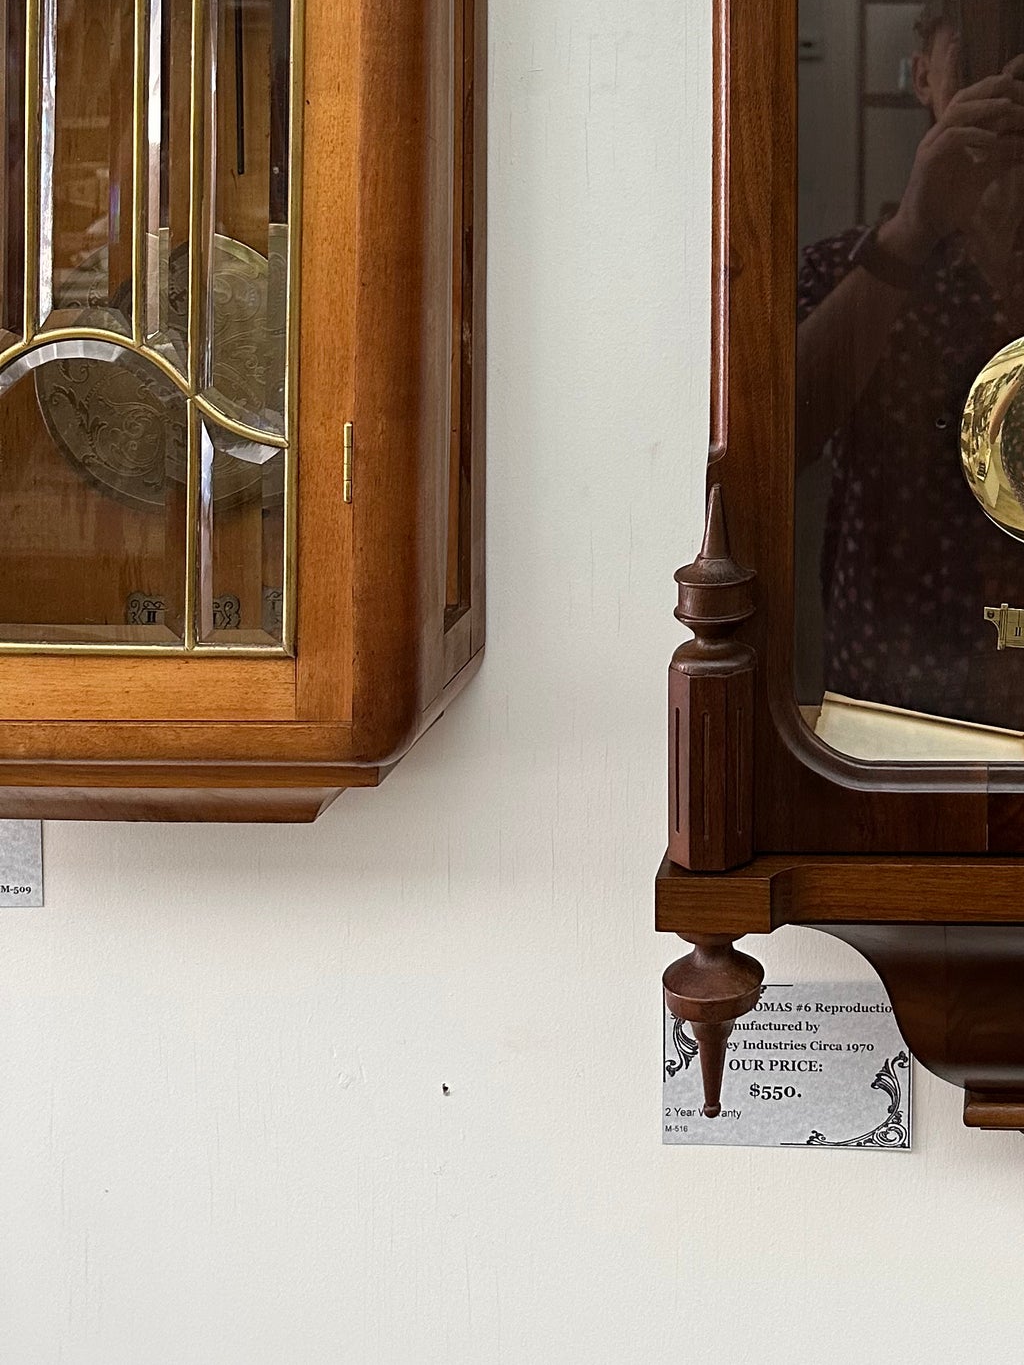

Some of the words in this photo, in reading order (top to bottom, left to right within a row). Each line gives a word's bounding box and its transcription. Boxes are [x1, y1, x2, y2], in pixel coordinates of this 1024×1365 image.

[796, 1002, 811, 1012] #6
[806, 1022, 820, 1033] by
[743, 1040, 806, 1050] Industries
[810, 1041, 842, 1051] Circa
[847, 1043, 874, 1053] 1970
[729, 1059, 765, 1071] OUR
[769, 1060, 823, 1072] PRICE:
[750, 1082, 802, 1100] $550.
[665, 1108, 671, 1116] 2
[674, 1108, 696, 1116] Year
